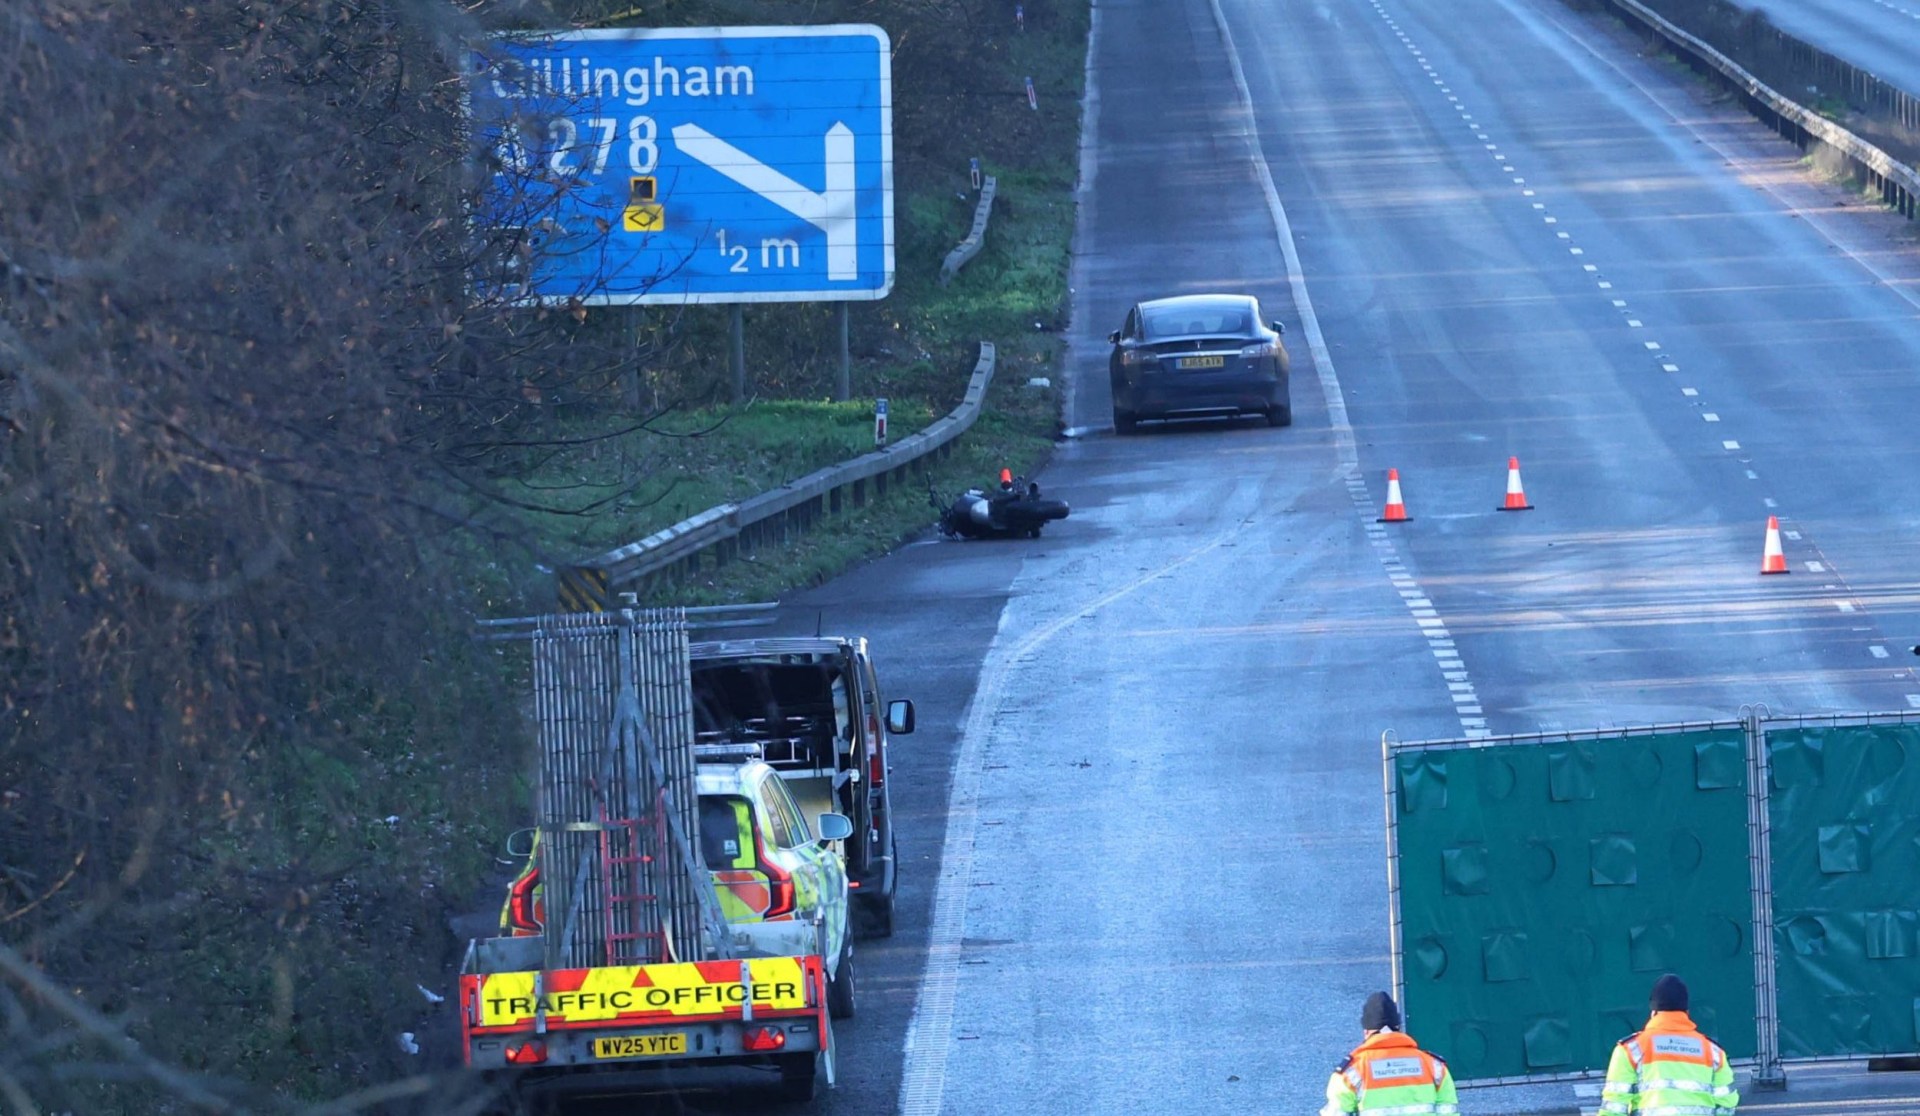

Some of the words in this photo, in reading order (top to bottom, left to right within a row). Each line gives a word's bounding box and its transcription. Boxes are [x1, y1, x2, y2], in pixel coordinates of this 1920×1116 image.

[760, 237, 800, 269] m
[486, 990, 633, 1016] TRAFFIC
[645, 982, 796, 1007] OFFICER
[601, 1038, 644, 1055] WV25
[648, 1036, 679, 1052] YTC
[1679, 1046, 1701, 1054] OFFICER
[1374, 1069, 1397, 1077] TRAFFIC
[1398, 1067, 1420, 1075] OFFICER
